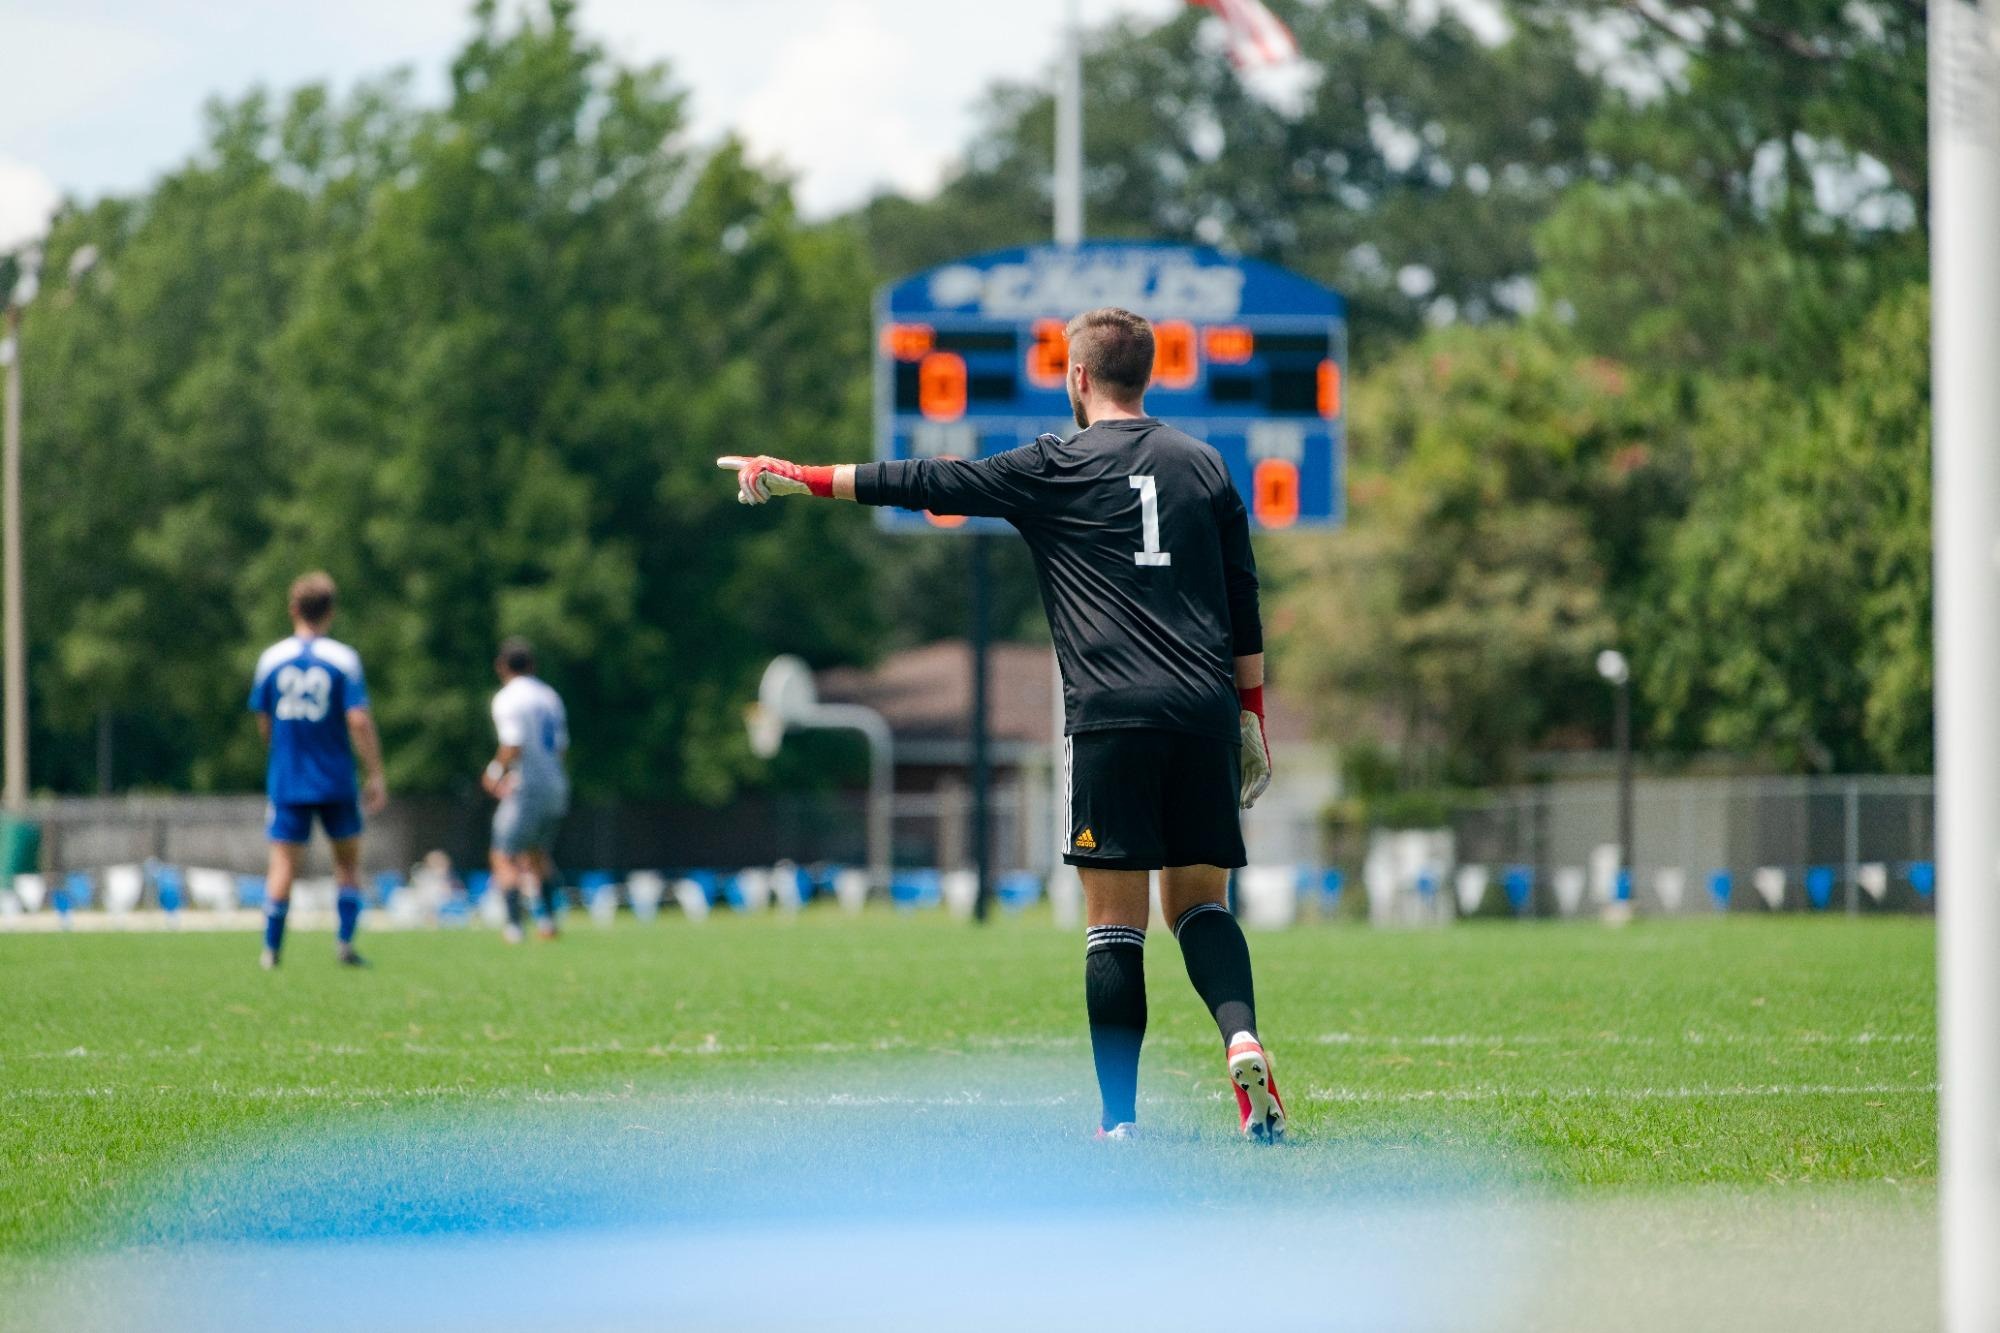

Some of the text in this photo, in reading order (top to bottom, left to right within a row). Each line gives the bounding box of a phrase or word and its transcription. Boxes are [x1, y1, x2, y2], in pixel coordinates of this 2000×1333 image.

[919, 351, 968, 423] 0
[1128, 475, 1171, 567] 1
[1253, 457, 1299, 529] 0
[275, 664, 332, 723] 23
